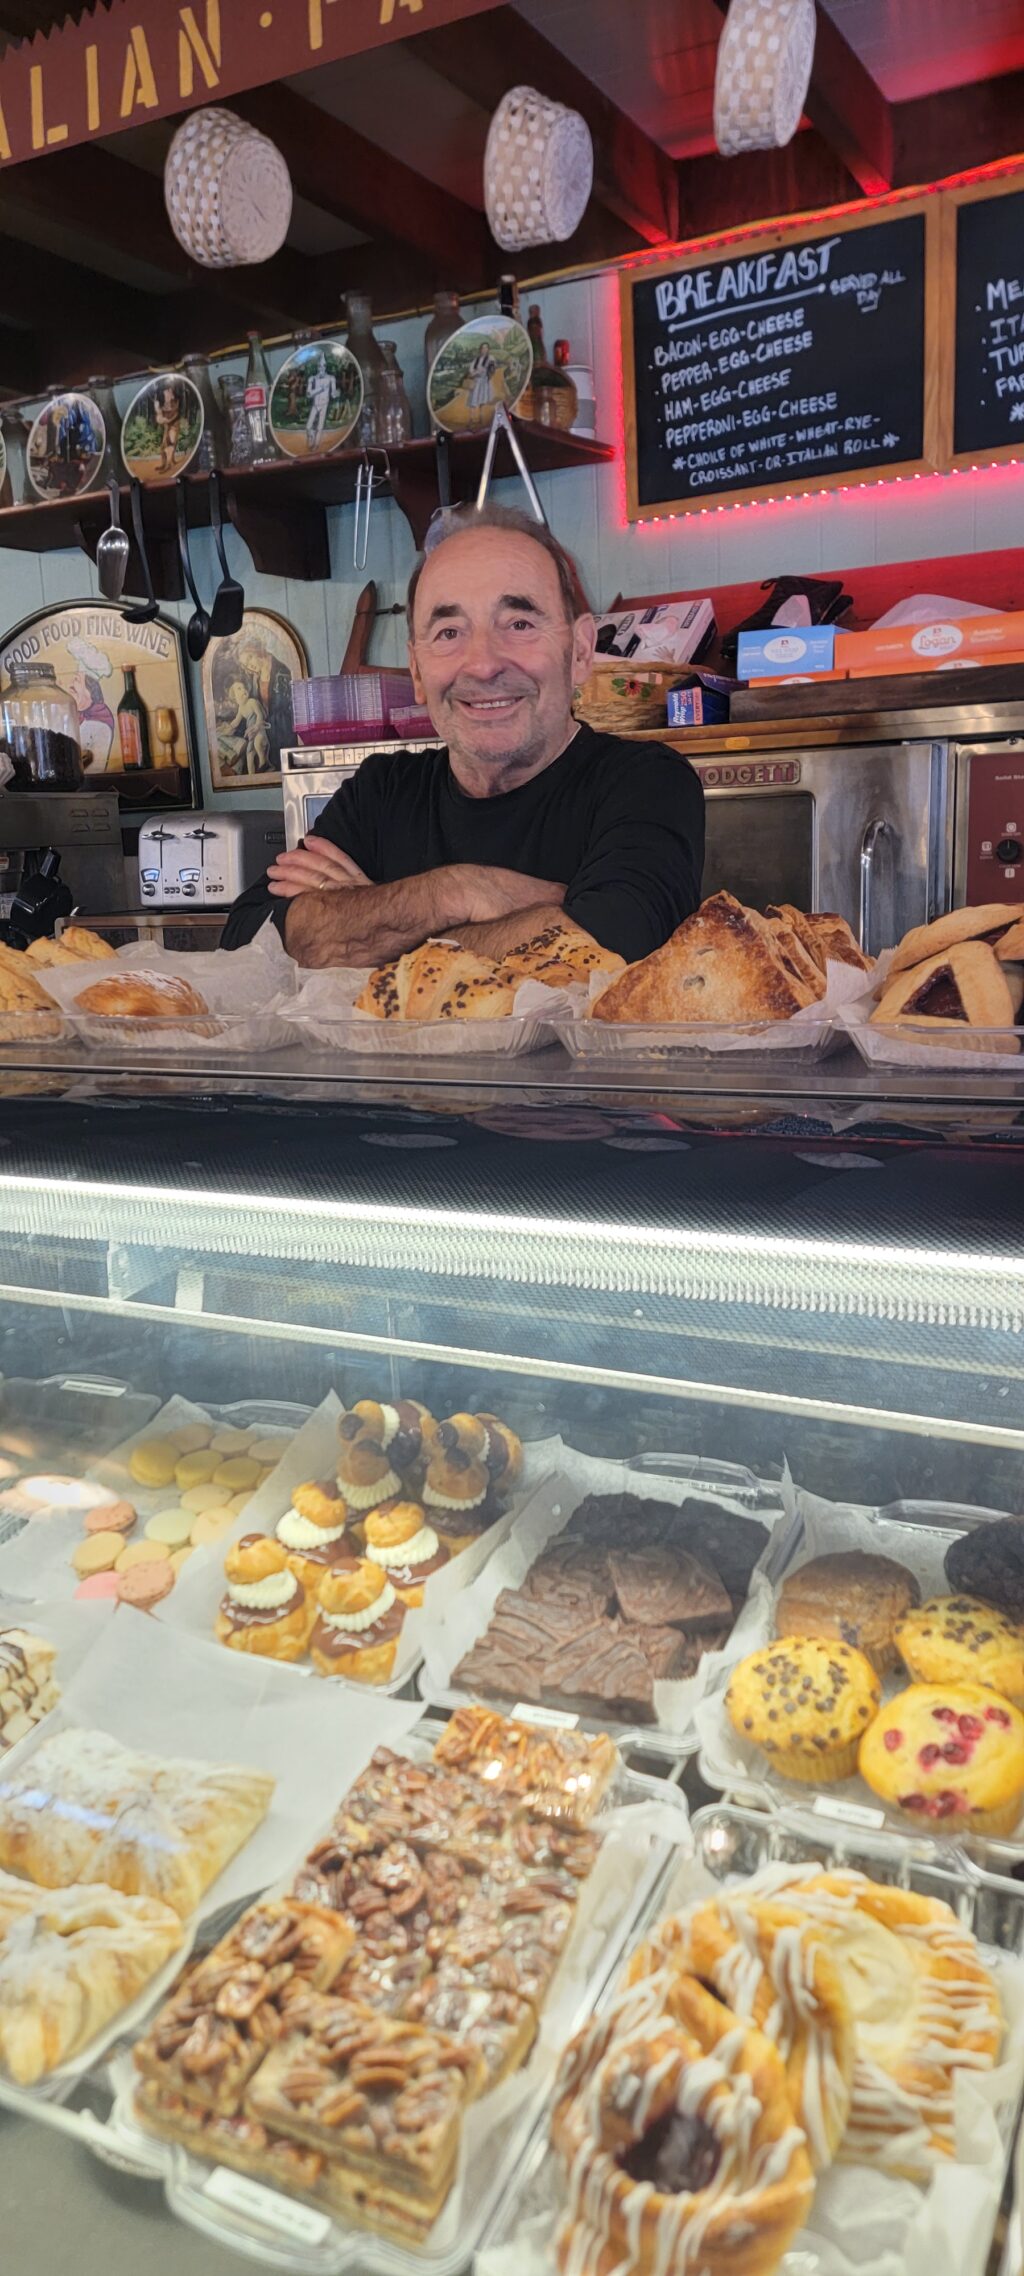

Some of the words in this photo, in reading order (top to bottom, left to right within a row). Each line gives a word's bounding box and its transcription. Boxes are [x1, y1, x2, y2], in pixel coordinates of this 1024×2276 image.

[0, 0, 222, 160] LIAN
[655, 238, 842, 321] BREAKFAST
[880, 270, 906, 285] ALL
[856, 287, 882, 313] DAY
[987, 278, 1024, 311] ME
[990, 313, 1024, 345] IT
[730, 443, 746, 459] OF
[4, 635, 41, 675] GOOD
[42, 617, 82, 647] FOOD
[87, 615, 122, 638] FINE
[126, 622, 171, 658] WINE
[918, 635, 957, 650] Logan
[699, 763, 790, 785] ODGETT
